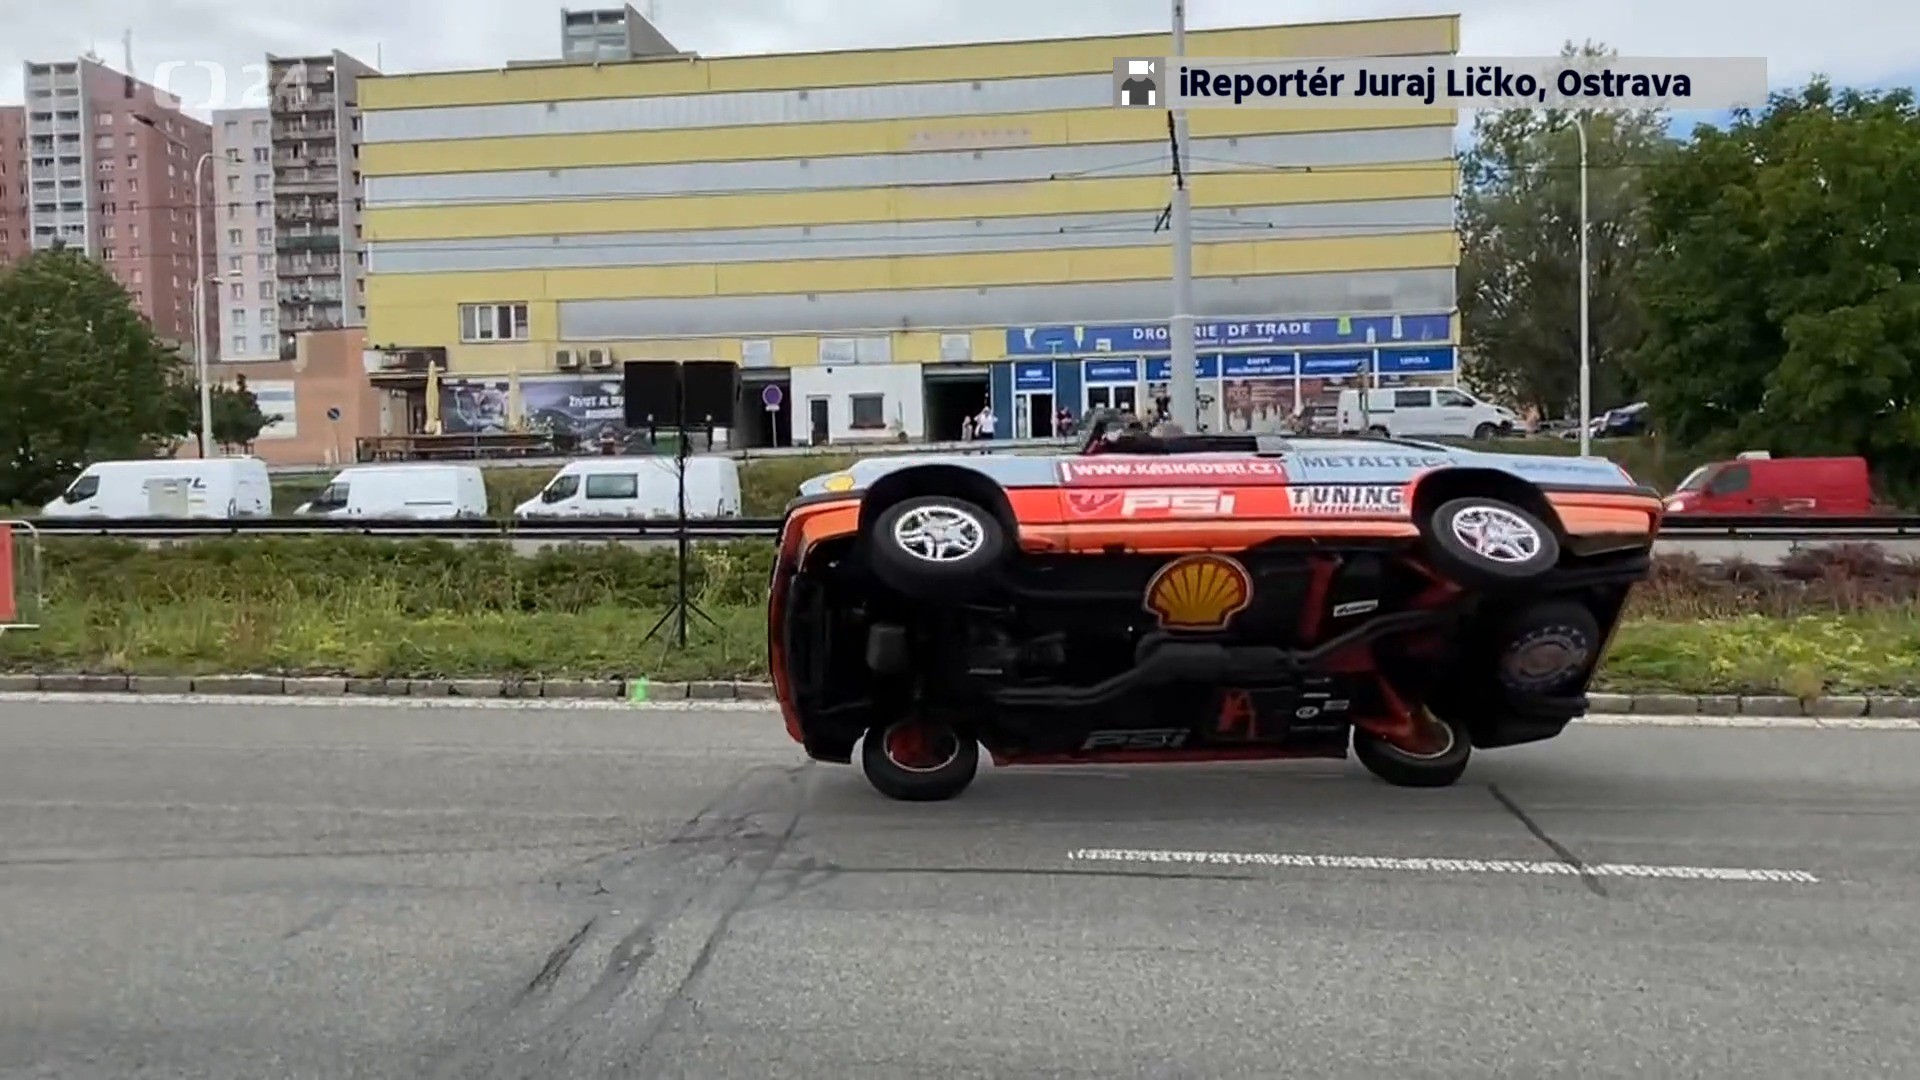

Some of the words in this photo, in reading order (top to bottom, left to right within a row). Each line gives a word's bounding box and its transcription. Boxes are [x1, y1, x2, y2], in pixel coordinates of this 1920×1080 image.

[1228, 324, 1249, 337] DF
[1255, 322, 1312, 335] TRADE
[1293, 487, 1402, 505] TUNING
